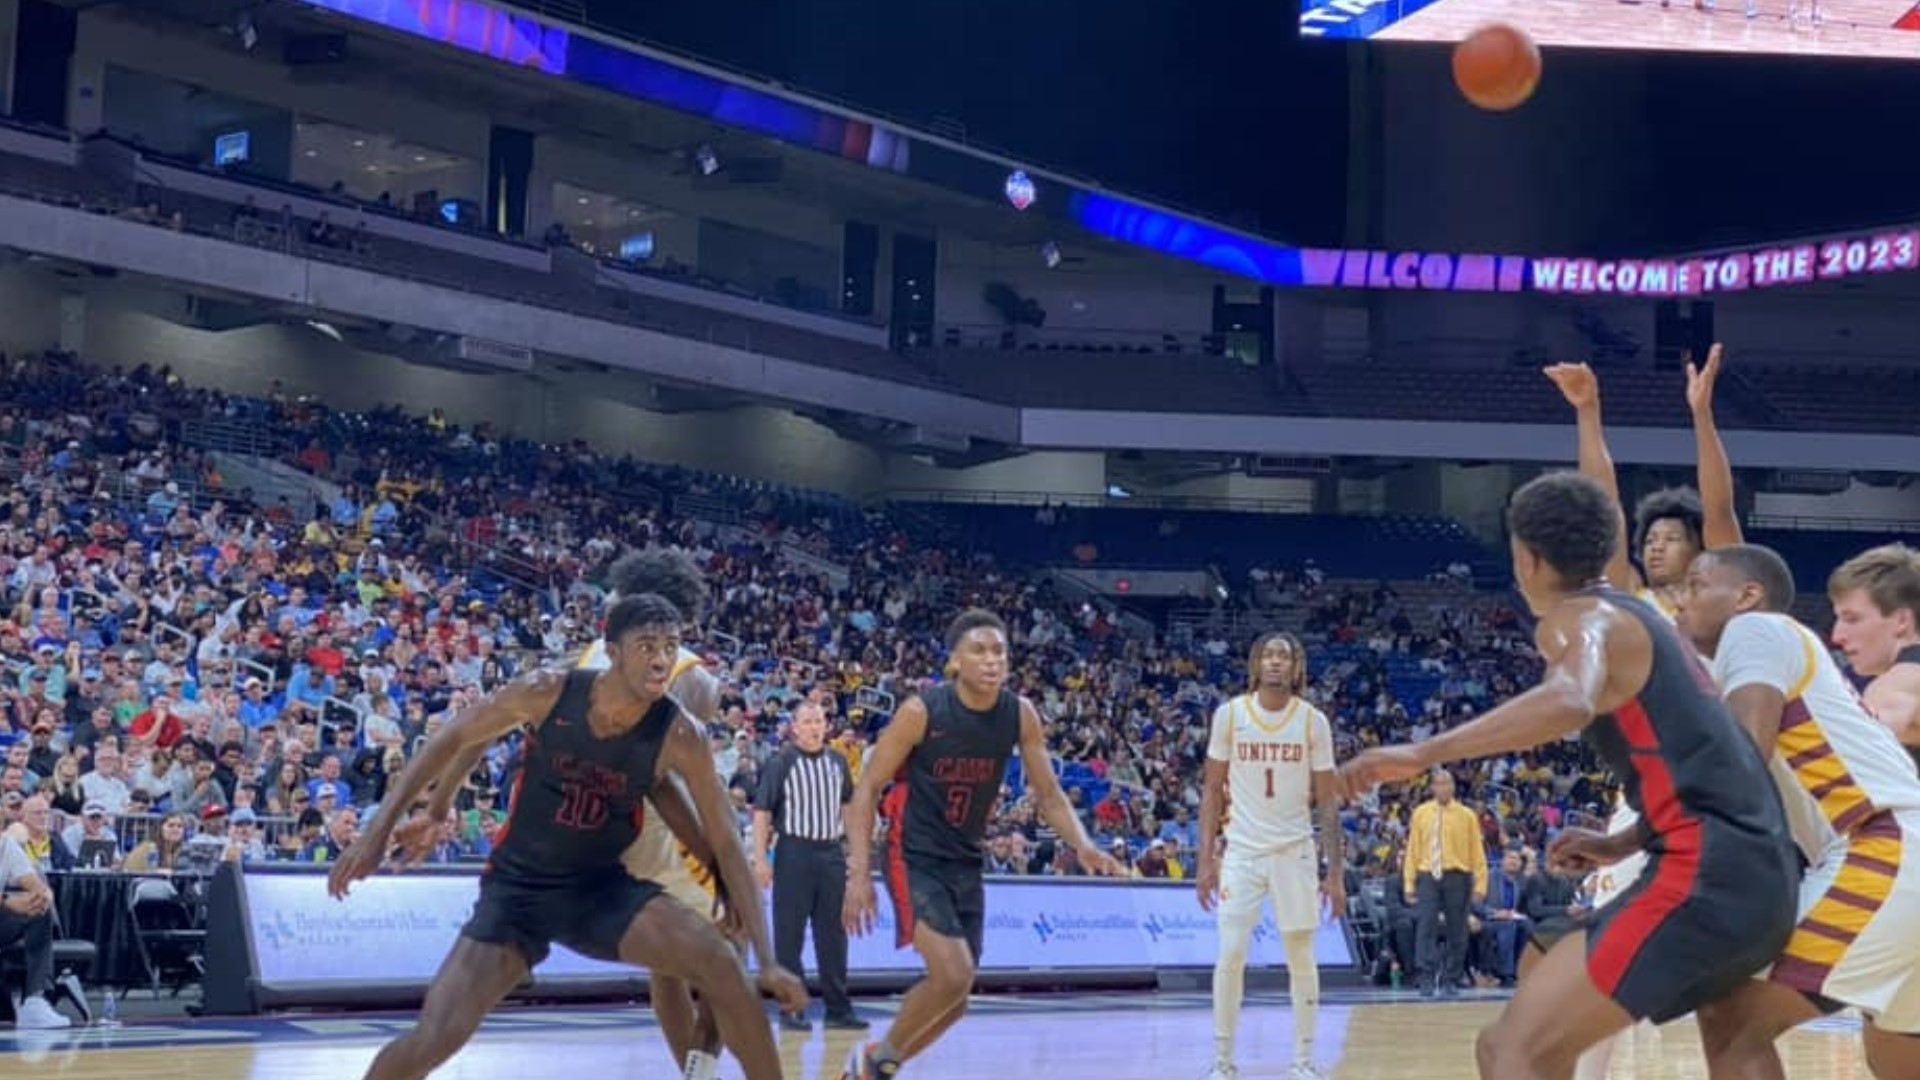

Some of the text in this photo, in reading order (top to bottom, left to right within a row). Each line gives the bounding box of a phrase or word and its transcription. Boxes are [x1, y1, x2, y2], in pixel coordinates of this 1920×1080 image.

[1532, 235, 1913, 293] WELCOME TO THE 2023
[1237, 742, 1303, 762] UNITED
[1265, 767, 1275, 799] 1
